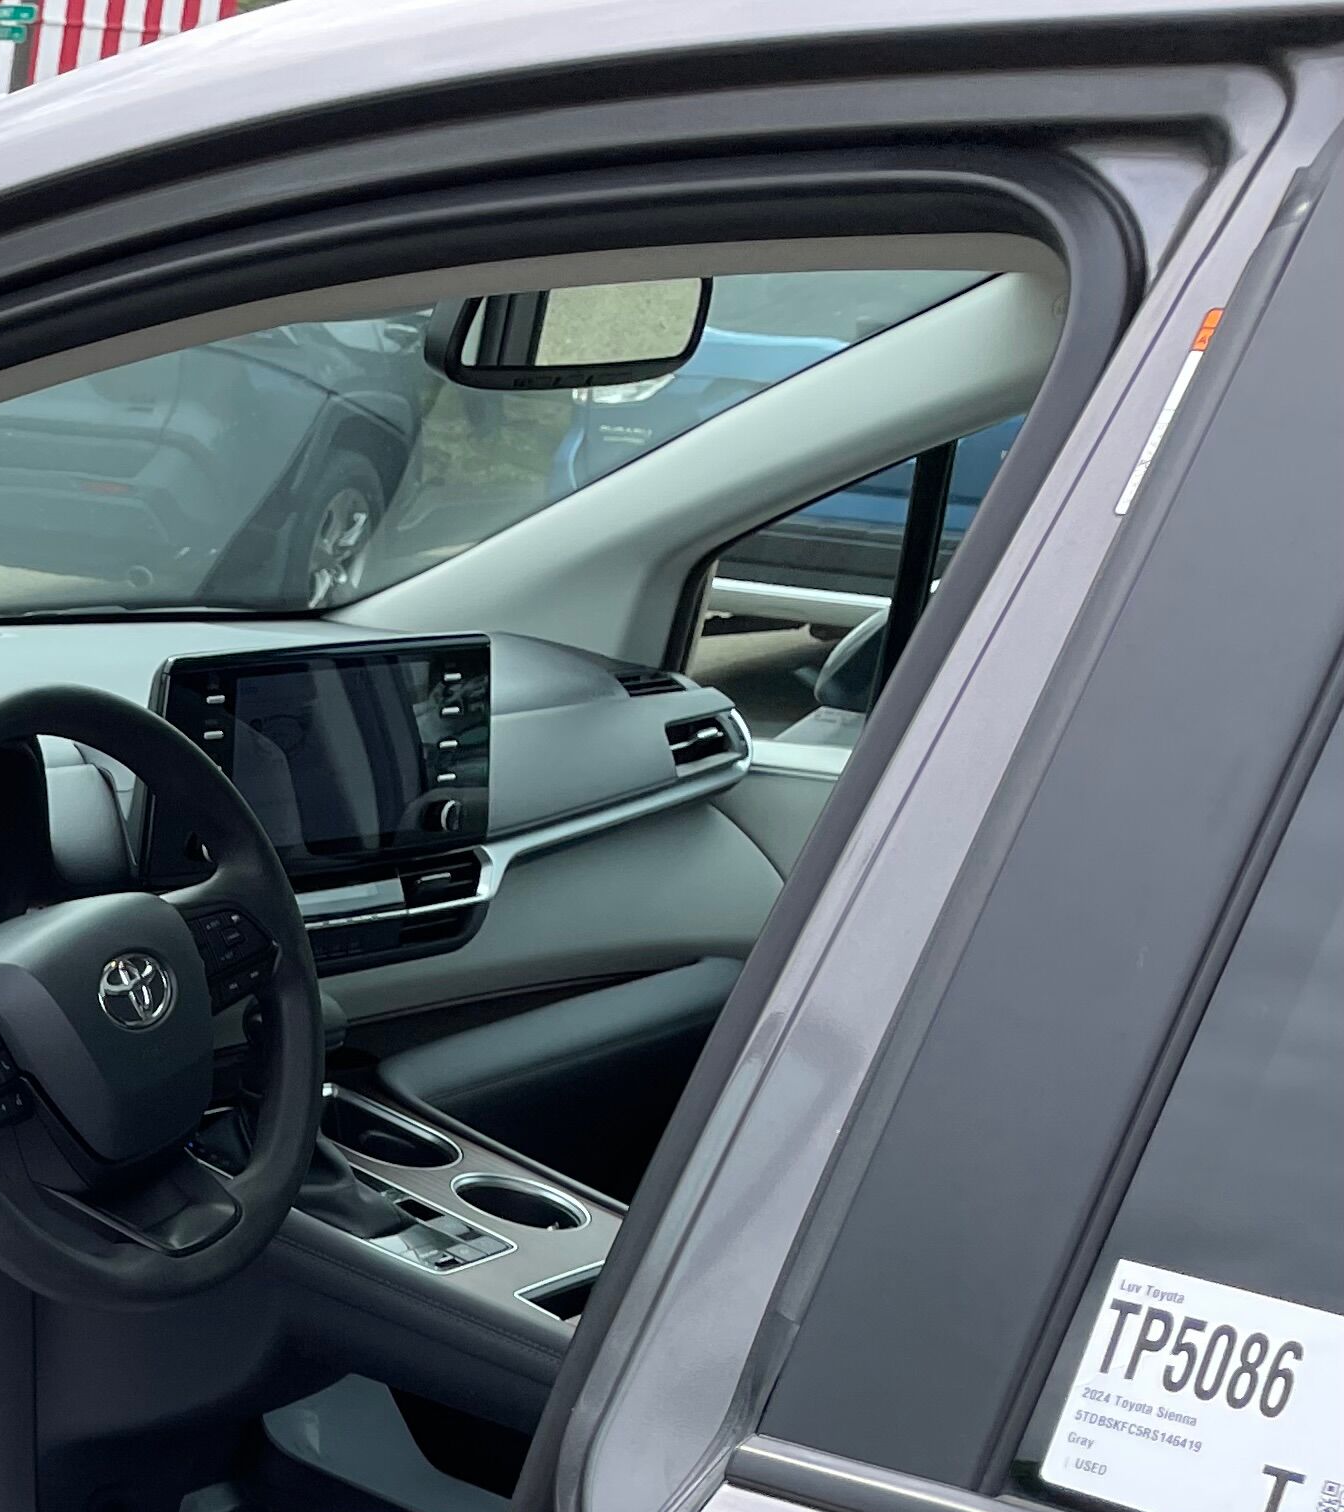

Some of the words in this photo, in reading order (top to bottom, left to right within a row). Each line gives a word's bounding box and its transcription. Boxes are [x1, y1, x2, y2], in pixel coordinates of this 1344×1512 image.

[1120, 1279, 1142, 1294] Luv
[1146, 1285, 1185, 1304] Toyota
[1099, 1297, 1304, 1418] TP5086
[1081, 1386, 1111, 1404] 2024
[1115, 1395, 1153, 1415] Toyota
[1156, 1406, 1198, 1427] Sienna
[1067, 1431, 1095, 1450] Gray
[1074, 1408, 1203, 1453] 5TDBSKFC5RS146419
[1074, 1457, 1108, 1476] USED
